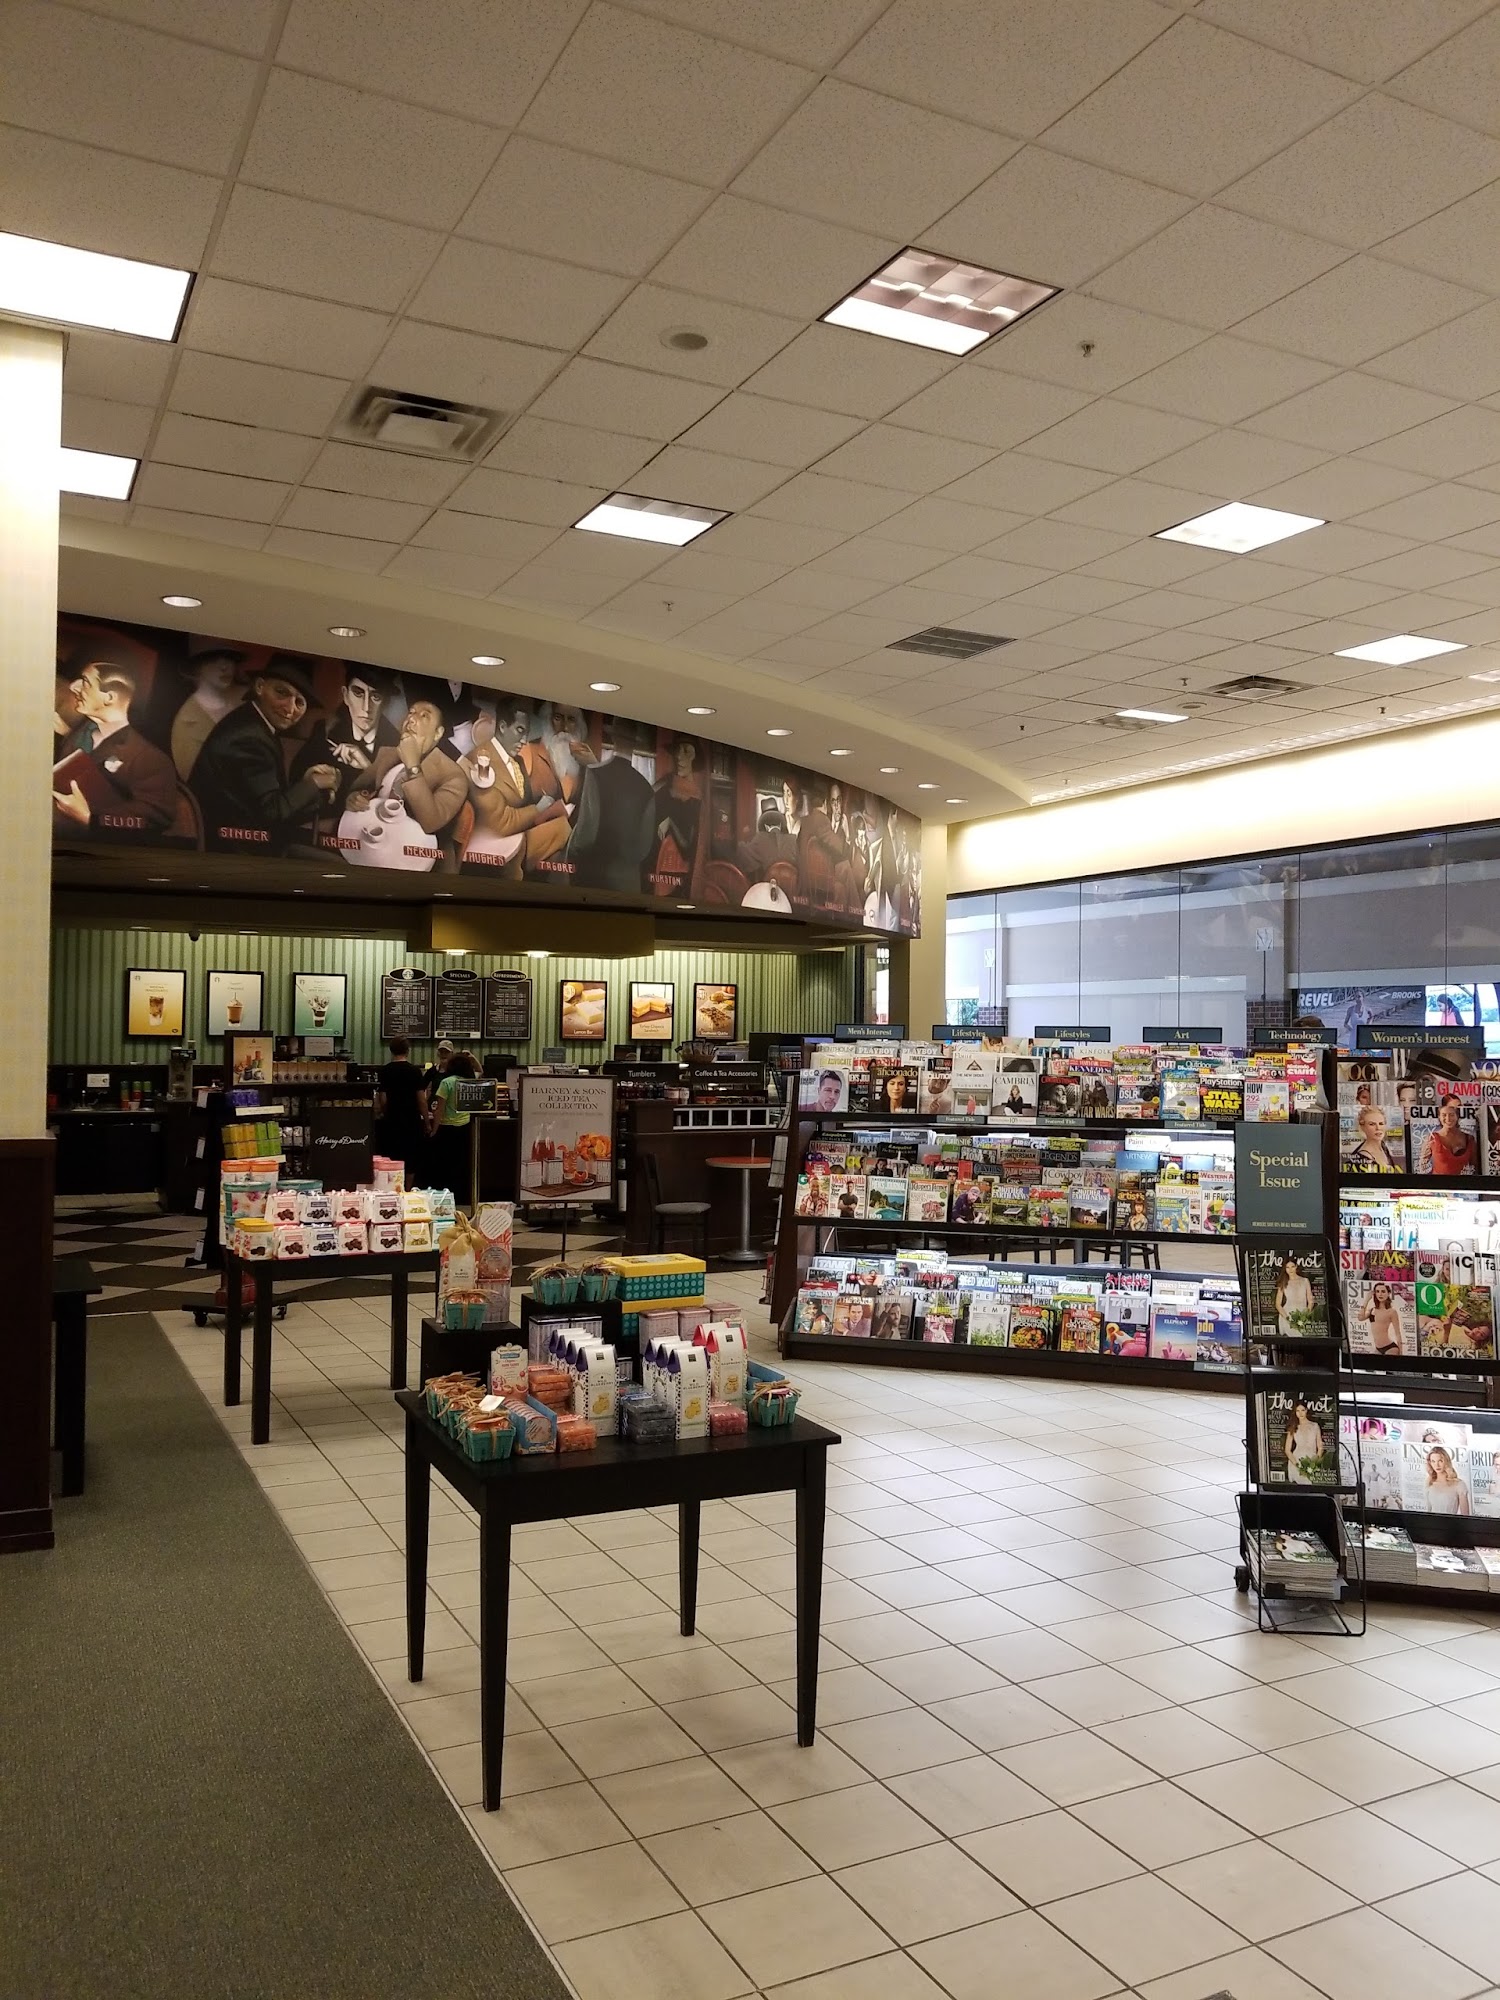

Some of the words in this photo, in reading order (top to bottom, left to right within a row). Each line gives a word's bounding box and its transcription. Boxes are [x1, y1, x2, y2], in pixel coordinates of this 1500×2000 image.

[104, 815, 143, 829] ELIOT
[219, 827, 269, 841] SINGER
[322, 838, 360, 850] KAFKA
[405, 846, 445, 859] NERUDA
[469, 853, 505, 866] HUGHES
[539, 861, 574, 873] TAGORE
[650, 874, 681, 886] HURSTON
[1297, 993, 1335, 1007] REVEL
[1391, 991, 1422, 999] BROOKS
[847, 1027, 865, 1035] Men's
[866, 1028, 892, 1036] Interest
[952, 1029, 986, 1038] Lifestyles
[1054, 1030, 1091, 1040] Lifestyles
[1174, 1031, 1190, 1039] Art
[1268, 1030, 1323, 1042] Technology
[1371, 1032, 1423, 1044] Women's
[1424, 1033, 1471, 1044] Interest
[858, 1047, 895, 1055] PLAYBOY
[1256, 1055, 1284, 1063] Digital
[628, 1070, 657, 1078] Tumblers
[994, 1077, 1035, 1085] CAMBRIA
[1200, 1078, 1243, 1087] PlayStation
[460, 1083, 485, 1092] Enter
[531, 1087, 571, 1095] HARNEY
[573, 1087, 580, 1095] &
[582, 1087, 607, 1095] SONS
[1246, 1084, 1263, 1094] HOW
[460, 1092, 485, 1100] HERE
[1119, 1090, 1139, 1099] DSLR
[1203, 1090, 1242, 1100] STAR
[539, 1102, 599, 1110] COLLECTION
[1203, 1100, 1242, 1109] WARS
[1094, 1106, 1116, 1118] WARS
[315, 1136, 338, 1149] Harry
[342, 1135, 369, 1145] David
[1249, 1150, 1309, 1171] Special
[1259, 1171, 1301, 1188] Issue
[1181, 1187, 1199, 1195] Draw
[1339, 1212, 1391, 1227] Runng
[1363, 1230, 1391, 1240] Country
[1258, 1249, 1283, 1268] the
[1289, 1249, 1322, 1268] not
[1382, 1251, 1409, 1265] Ms.
[1348, 1281, 1414, 1300] SHPE
[1420, 1284, 1443, 1306] O
[1109, 1299, 1146, 1308] TANK
[1421, 1347, 1479, 1359] BOOKS!
[1268, 1391, 1293, 1410] the
[1299, 1392, 1333, 1413] not
[1403, 1443, 1468, 1463] INSDE
[1409, 1463, 1421, 1471] 102
